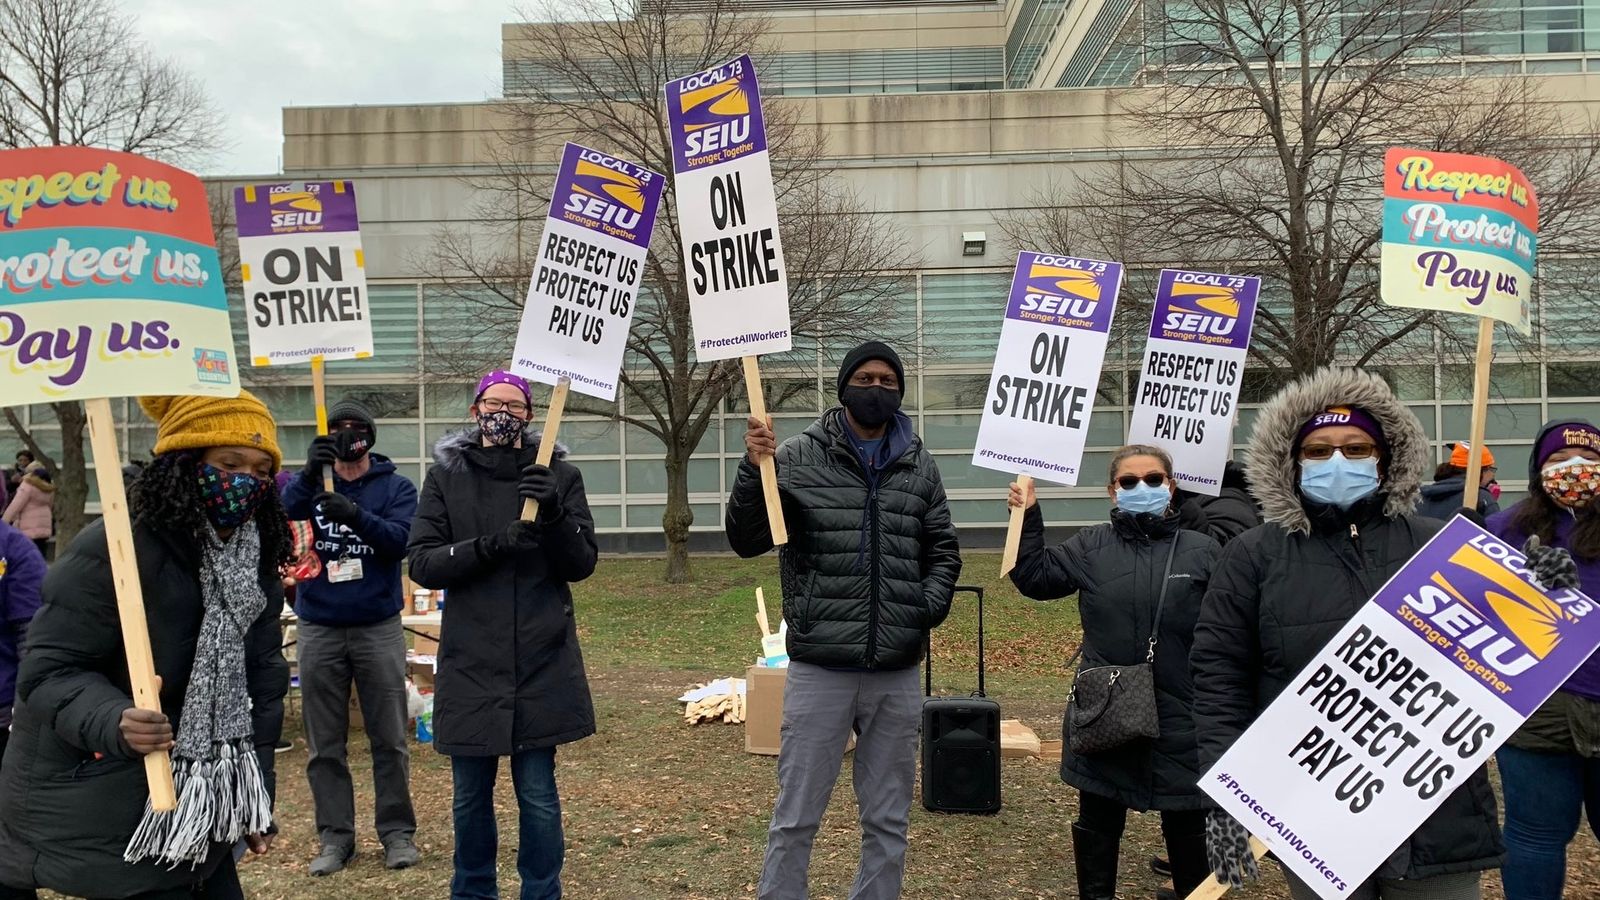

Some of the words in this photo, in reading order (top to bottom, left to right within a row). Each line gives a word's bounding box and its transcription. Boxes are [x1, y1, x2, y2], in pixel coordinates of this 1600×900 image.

[679, 64, 727, 94] LOCAL
[729, 60, 743, 76] 73
[684, 115, 750, 157] SEIU
[579, 149, 630, 174] LOCAL
[634, 165, 652, 182] 73
[687, 151, 721, 167] Stronger
[723, 141, 754, 160] Together
[0, 163, 121, 227] spect
[125, 175, 179, 212] us.
[269, 185, 292, 194] LOC
[306, 184, 320, 192] 73
[1398, 156, 1511, 199] Respect
[563, 193, 641, 230] SEIU
[710, 171, 746, 231] ON
[270, 212, 322, 228] SEIU
[564, 211, 600, 229] Stronger
[602, 223, 636, 241] Together
[1406, 203, 1516, 246] Protect
[0, 236, 150, 291] rotect
[157, 249, 209, 284] us.
[262, 246, 344, 285] ON
[544, 232, 616, 278] RESPECT
[617, 252, 638, 286] US
[691, 228, 779, 296] STRIKE
[1033, 254, 1083, 270] LOCAL
[1088, 261, 1107, 272] 73
[535, 266, 608, 310] PROTECT
[610, 287, 631, 318] US
[1174, 273, 1224, 286] LOCAL
[1227, 278, 1246, 288] 73
[1417, 251, 1490, 306] Pay
[1496, 272, 1519, 297] us.
[254, 286, 362, 328] STRIKE!
[1020, 294, 1098, 318] SEIU
[1020, 310, 1056, 324] Stronger
[1057, 316, 1094, 328] Together
[108, 320, 180, 352] us.
[548, 305, 581, 337] PAY
[582, 315, 604, 344] US
[700, 329, 788, 349] #ProtectAllWorkers
[1162, 313, 1238, 335] SEIU
[1162, 329, 1198, 341] Stronger
[1198, 334, 1233, 345] Together
[269, 346, 356, 358] #ProtectAllWorkers
[1030, 332, 1070, 377] ON
[1147, 351, 1214, 382] RESPECT
[1217, 360, 1238, 386] US
[992, 375, 1088, 429] STRIKE
[1141, 382, 1208, 413] PROTECT
[1210, 391, 1232, 417] US
[1154, 414, 1182, 441] PAY
[1184, 419, 1205, 445] US
[1315, 414, 1350, 426] SEIU
[1566, 436, 1589, 445] UNION
[979, 449, 1075, 475] #ProtectAllWorkers
[1173, 472, 1218, 486] llWorkers
[315, 541, 339, 552] OFF
[1556, 589, 1594, 617] 73
[1402, 584, 1540, 677] SEIU
[1397, 605, 1453, 650] Stronger
[1453, 645, 1512, 696] Together
[1334, 624, 1459, 727] RESPECT
[1442, 707, 1495, 759] US
[1297, 664, 1420, 767] PROTECT
[1402, 748, 1455, 800] US
[1288, 725, 1353, 782] PAY
[1334, 763, 1384, 814] US
[1216, 772, 1347, 891] #ProtectAllWorkers
